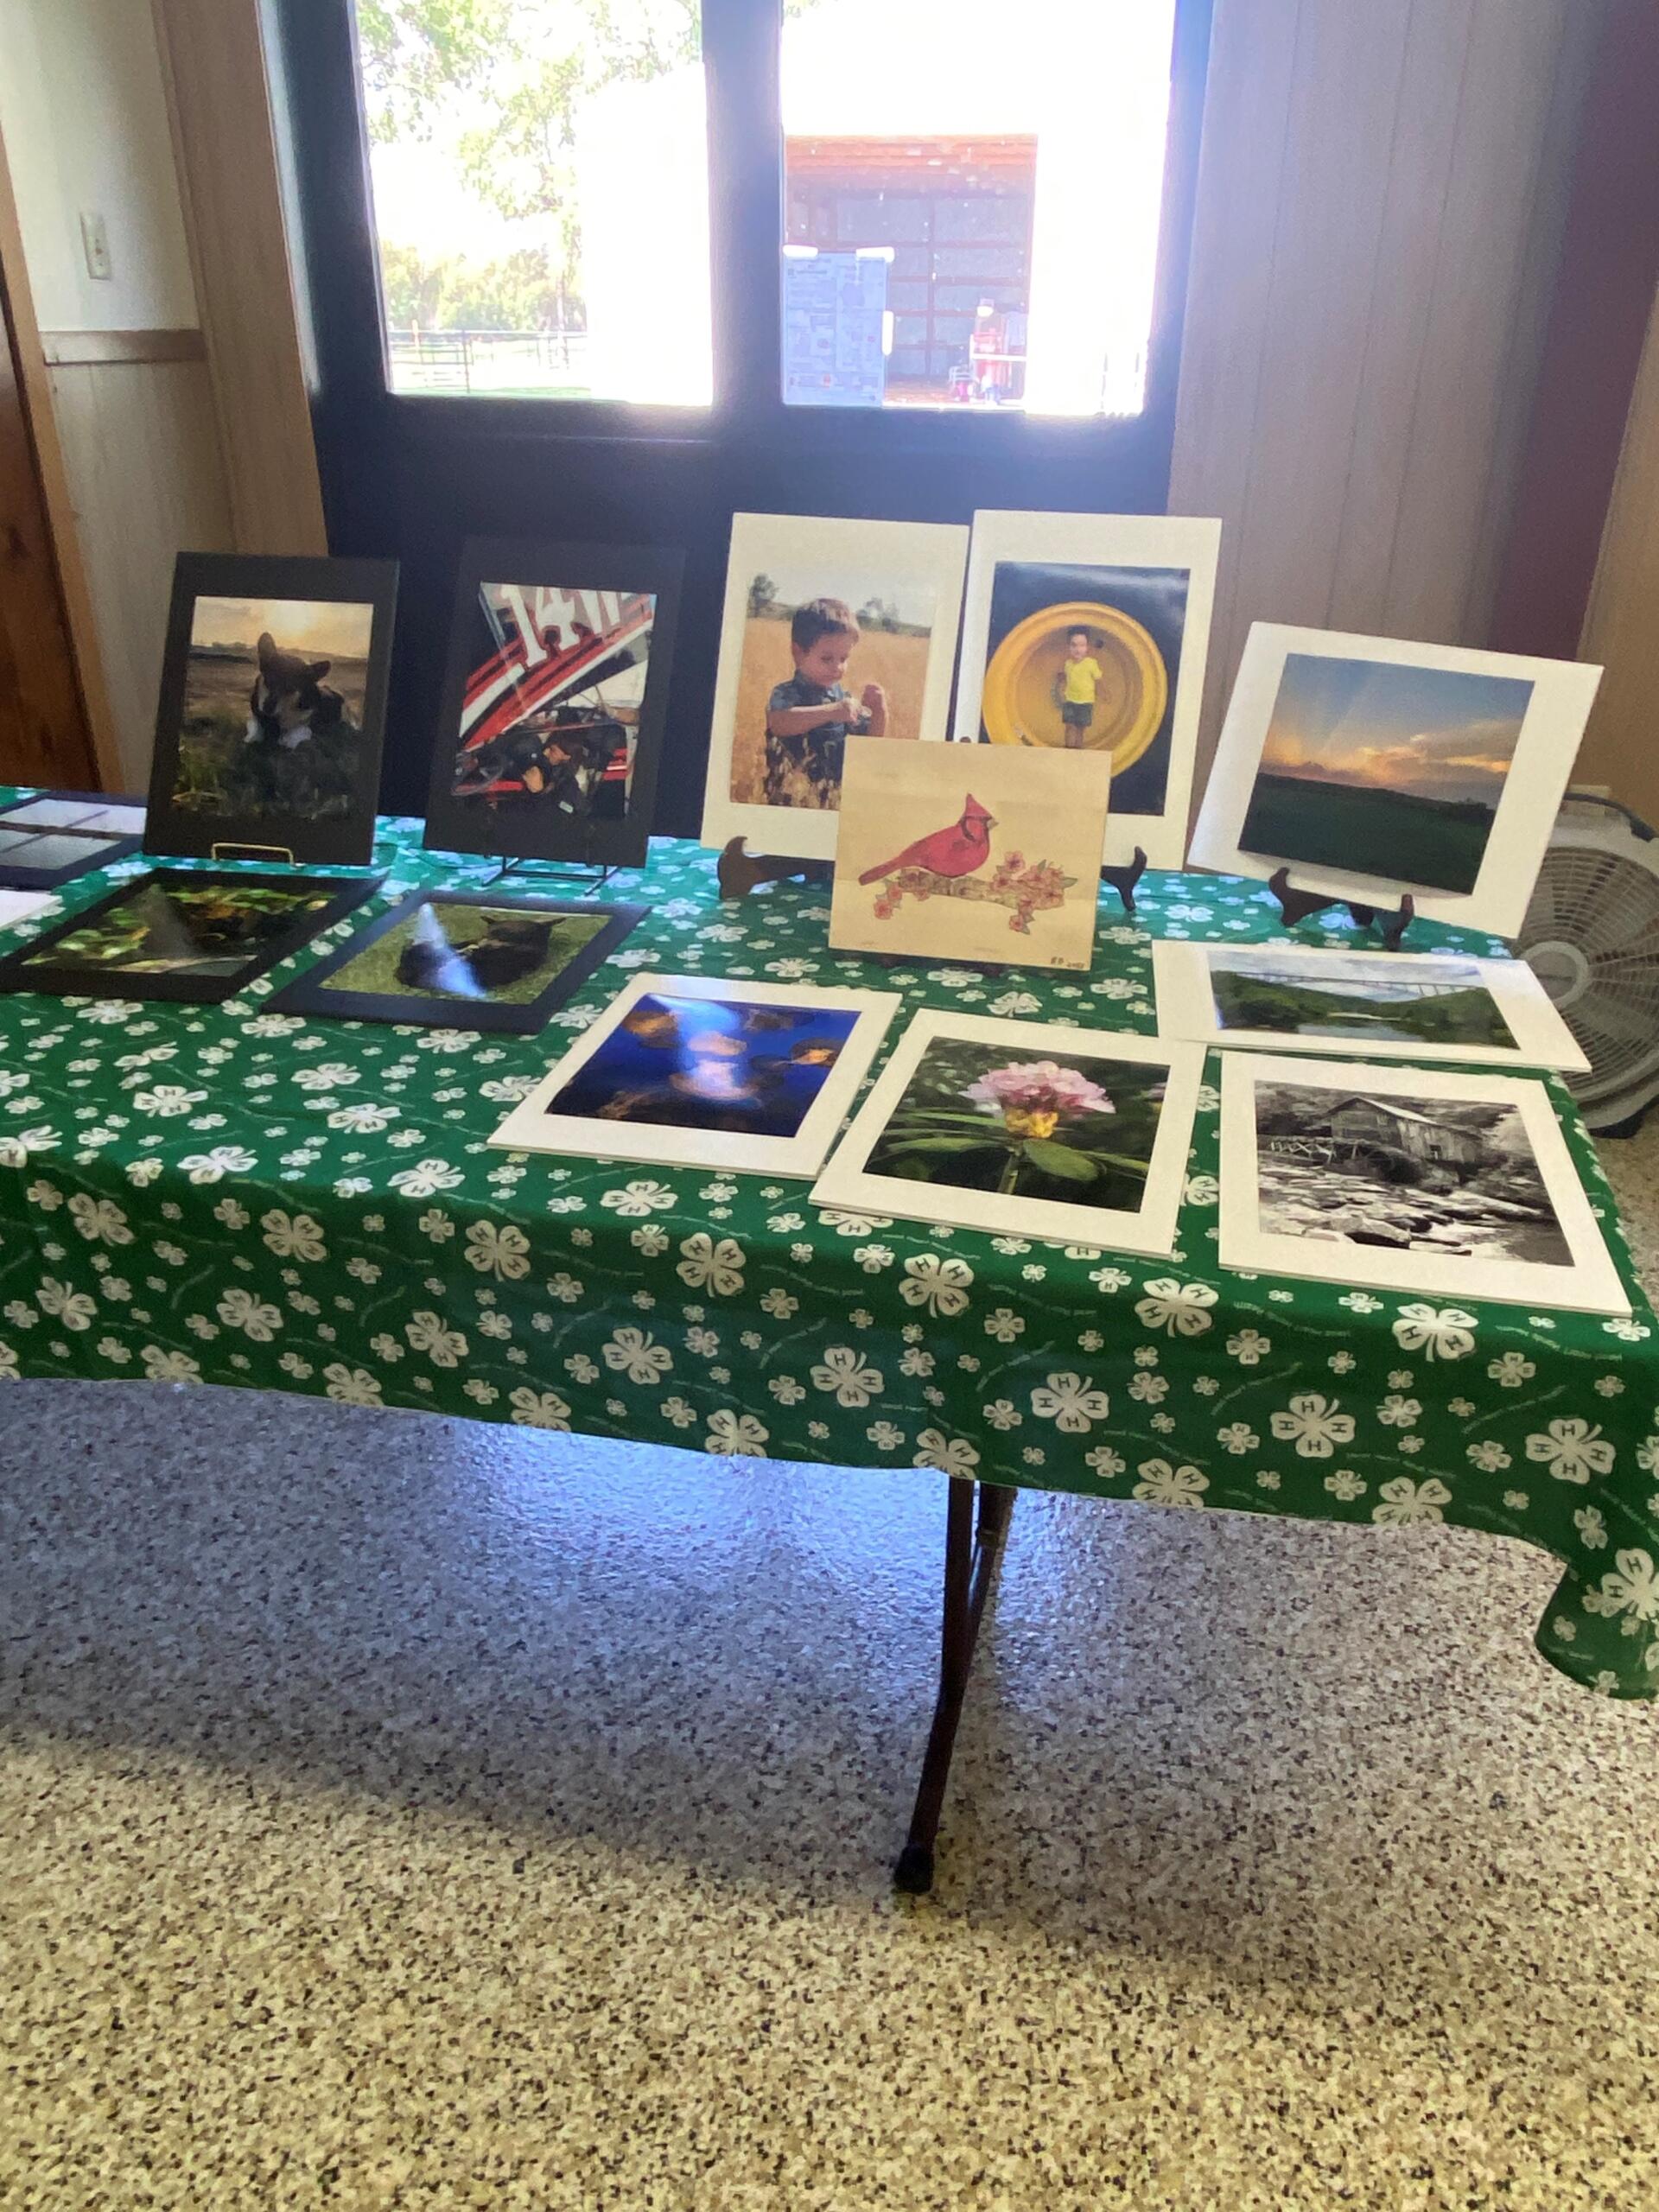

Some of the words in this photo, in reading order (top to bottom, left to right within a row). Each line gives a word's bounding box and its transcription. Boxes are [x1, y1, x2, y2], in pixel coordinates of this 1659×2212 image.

[411, 1185, 426, 1194] H
[475, 1228, 490, 1242] H
[849, 1224, 861, 1233] H
[505, 1235, 522, 1248] H
[690, 1240, 704, 1255] H
[721, 1248, 736, 1261] H
[1077, 1247, 1089, 1255] H
[472, 1252, 487, 1264] H
[507, 1258, 522, 1273] H
[915, 1258, 931, 1273] H
[684, 1266, 701, 1279] H
[948, 1265, 965, 1281] H
[720, 1274, 736, 1287] H
[1154, 1281, 1172, 1292] H
[907, 1285, 924, 1297] H
[1190, 1287, 1210, 1299] H
[944, 1293, 960, 1307] H
[1145, 1306, 1160, 1319] H
[1447, 1313, 1466, 1322] H
[1186, 1315, 1200, 1328] H
[620, 1332, 635, 1344] H
[1402, 1325, 1421, 1341] H
[1445, 1335, 1463, 1351] H
[437, 1352, 449, 1363] H
[609, 1351, 624, 1362] H
[652, 1354, 666, 1363] H
[834, 1353, 847, 1367] H
[638, 1369, 651, 1381] H
[817, 1374, 833, 1383] H
[862, 1376, 877, 1386] H
[1058, 1376, 1071, 1389] H
[846, 1390, 859, 1402] H
[1039, 1397, 1053, 1408] H
[547, 1401, 563, 1411] H
[1087, 1399, 1102, 1411] H
[1301, 1401, 1315, 1414] H
[715, 1416, 731, 1430] H
[745, 1423, 760, 1434] H
[1066, 1417, 1080, 1427] H
[1279, 1421, 1295, 1431] H
[1332, 1422, 1347, 1433] H
[1561, 1424, 1575, 1437] H
[955, 1446, 970, 1459] H
[1307, 1440, 1321, 1452] H
[1534, 1443, 1551, 1454] H
[1590, 1448, 1607, 1463] H
[1147, 1465, 1165, 1478] H
[1562, 1463, 1577, 1476] H
[1182, 1473, 1199, 1484] H
[1141, 1490, 1156, 1500] H
[1389, 1484, 1408, 1498] H
[1425, 1484, 1443, 1498] H
[1380, 1509, 1399, 1526] H
[1625, 1557, 1643, 1574] H
[1608, 1585, 1624, 1599] H
